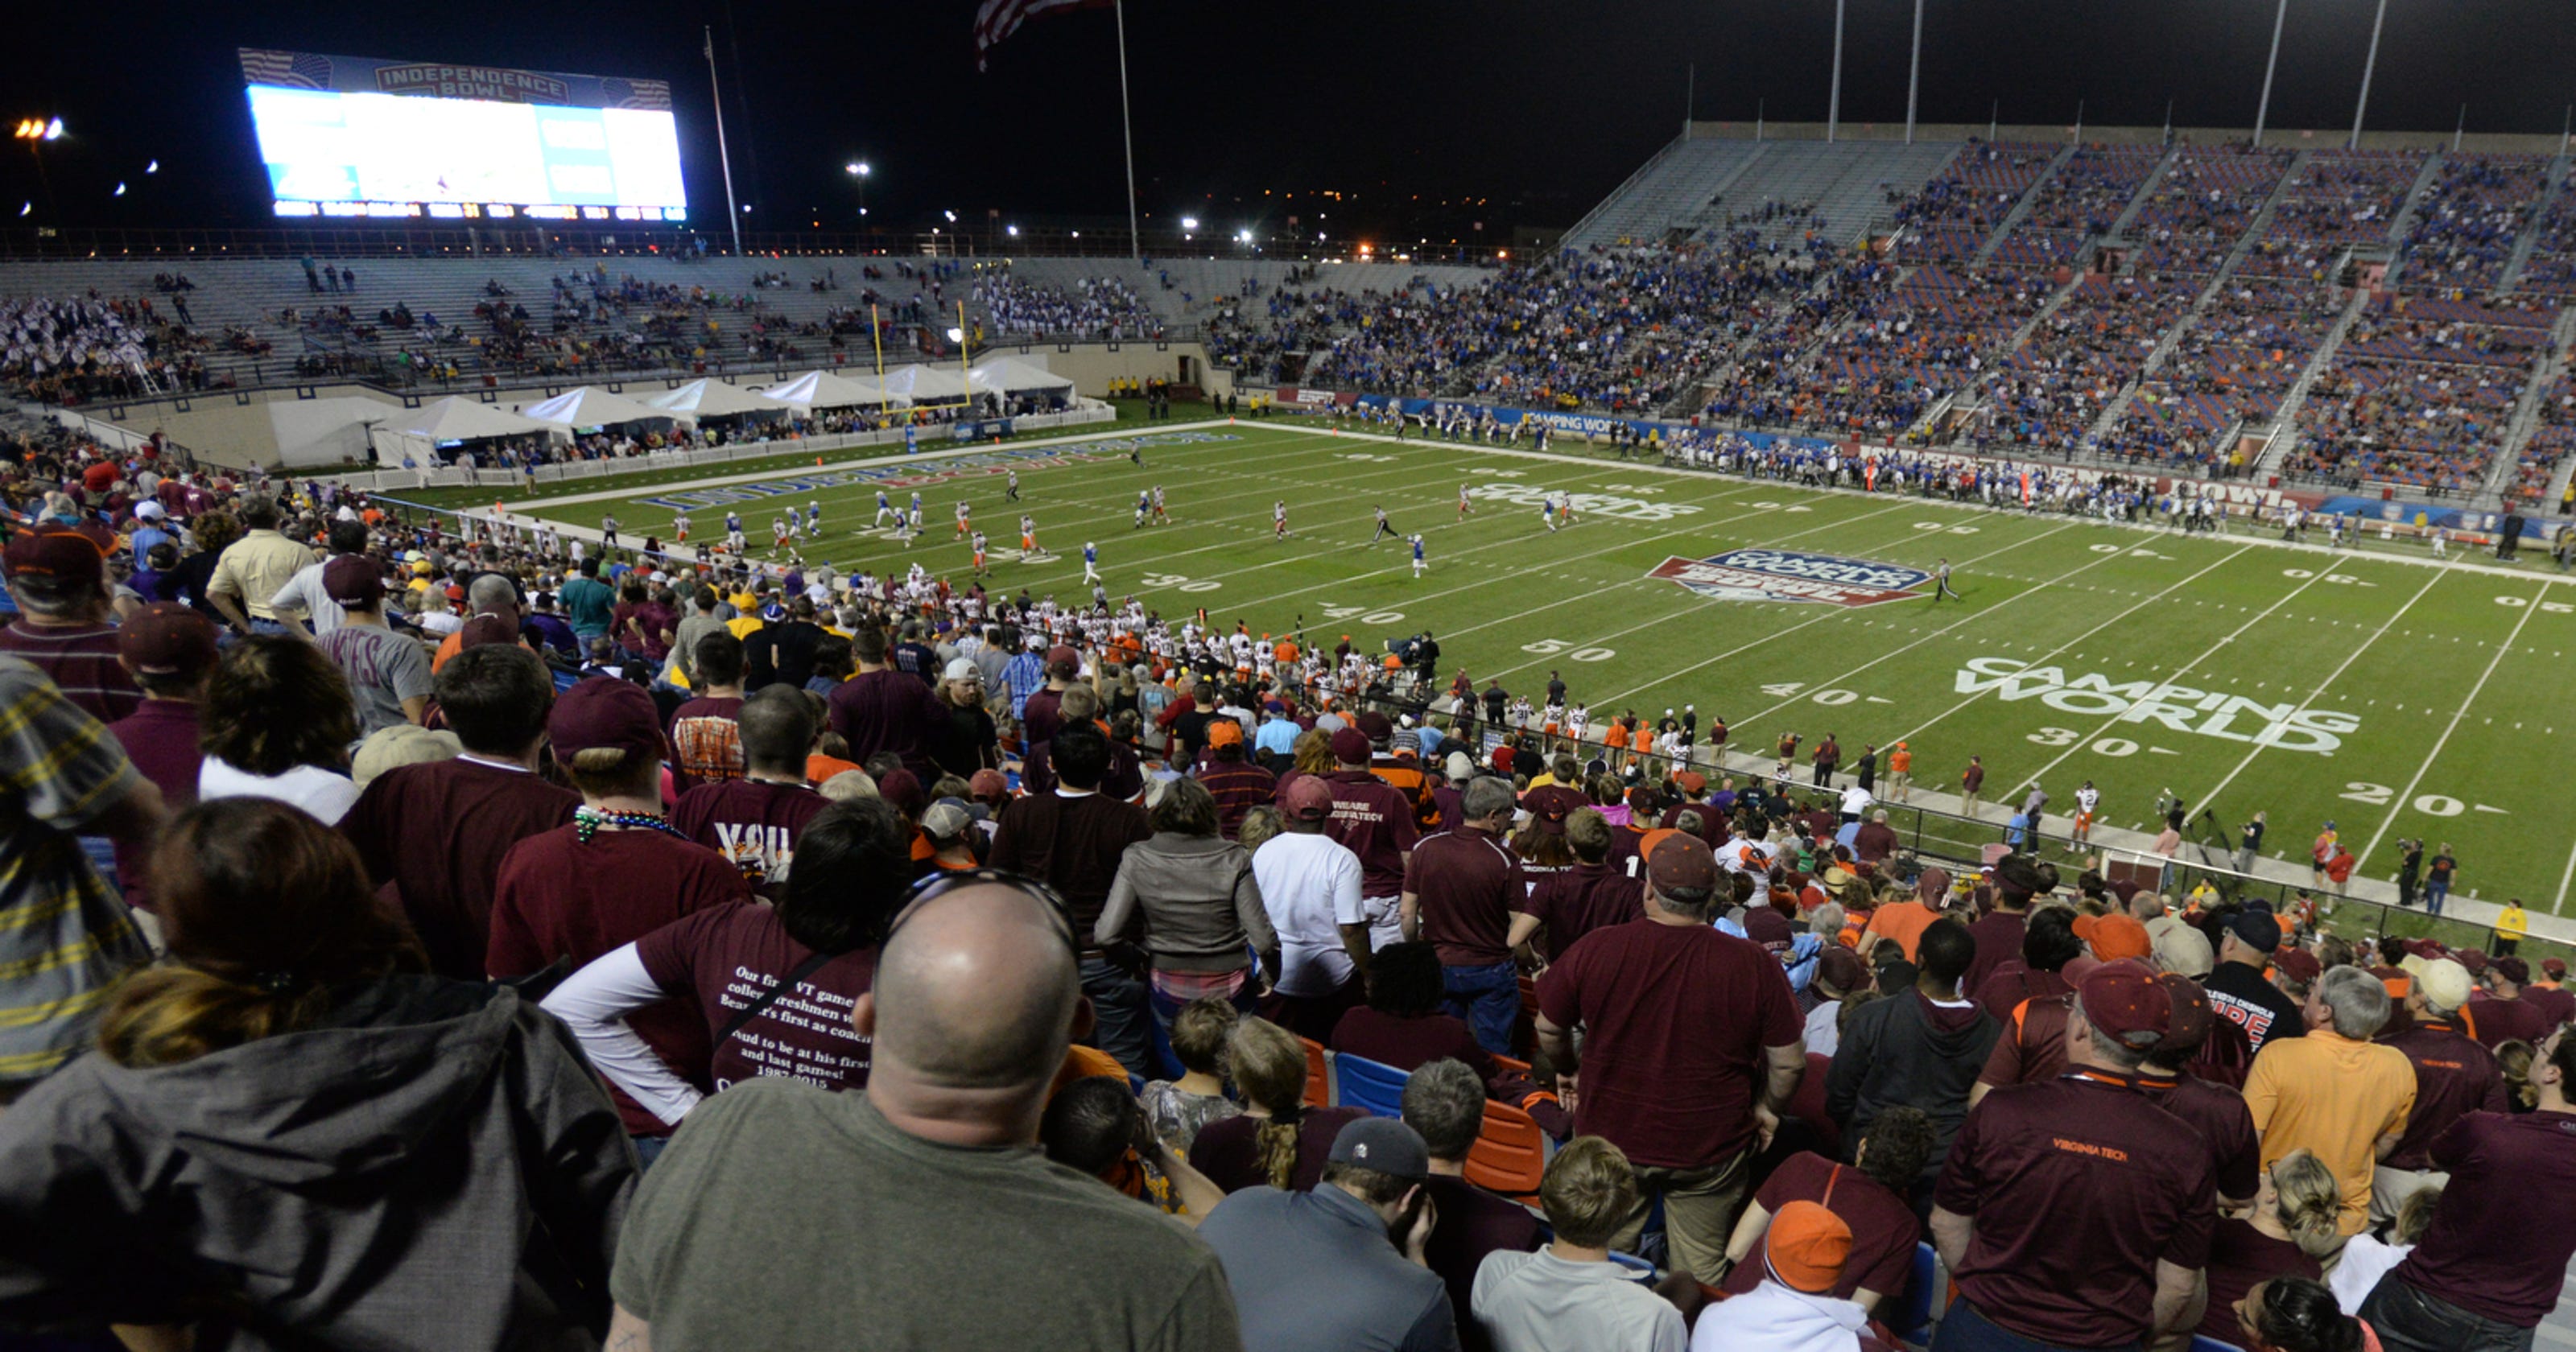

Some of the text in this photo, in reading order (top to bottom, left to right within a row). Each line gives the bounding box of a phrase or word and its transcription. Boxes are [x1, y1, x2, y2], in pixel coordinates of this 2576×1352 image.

[383, 68, 563, 97] INDEPENDENCE
[440, 82, 515, 99] BOWL
[2171, 478, 2298, 508] BOWL
[1726, 556, 1901, 588] WORLD
[1736, 552, 1918, 582] CAMPING
[1966, 657, 2362, 734] CAMPING
[1954, 670, 2342, 752] WORLD
[2338, 781, 2465, 816] 20
[1625, 855, 1639, 878] 1
[727, 982, 766, 1000] colleg
[736, 966, 759, 983] Our
[762, 975, 780, 988] fir
[795, 981, 817, 996] VT
[719, 993, 778, 1020] Bear's
[780, 1011, 810, 1028] first
[811, 1021, 828, 1033] as
[731, 1028, 870, 1069] And to be at his first
[740, 1047, 844, 1080] and last games!
[2053, 1137, 2129, 1161] VIRGINIA TECH
